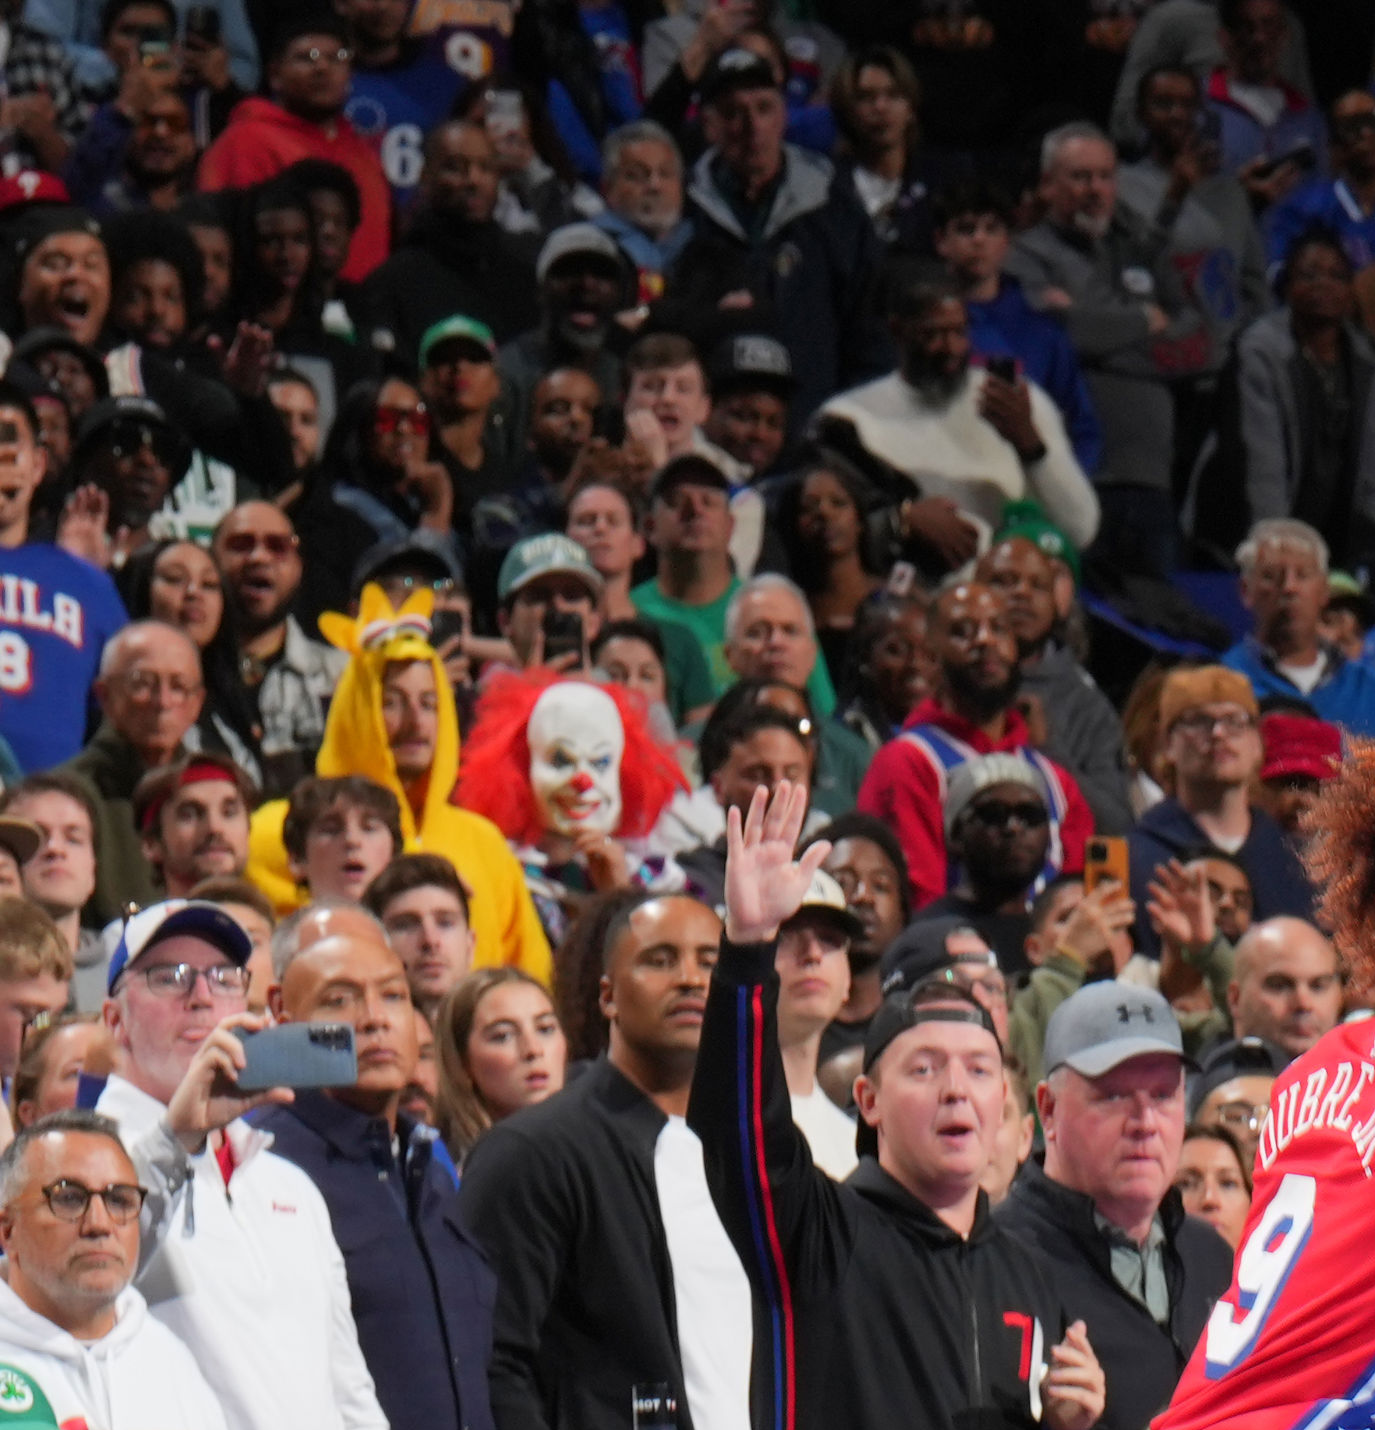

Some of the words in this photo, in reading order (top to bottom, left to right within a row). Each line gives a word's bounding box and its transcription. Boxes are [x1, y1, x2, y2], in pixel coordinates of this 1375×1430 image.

[0, 573, 84, 648] ILA
[1258, 1061, 1375, 1173] OUBRE
[1204, 1172, 1317, 1380] 9
